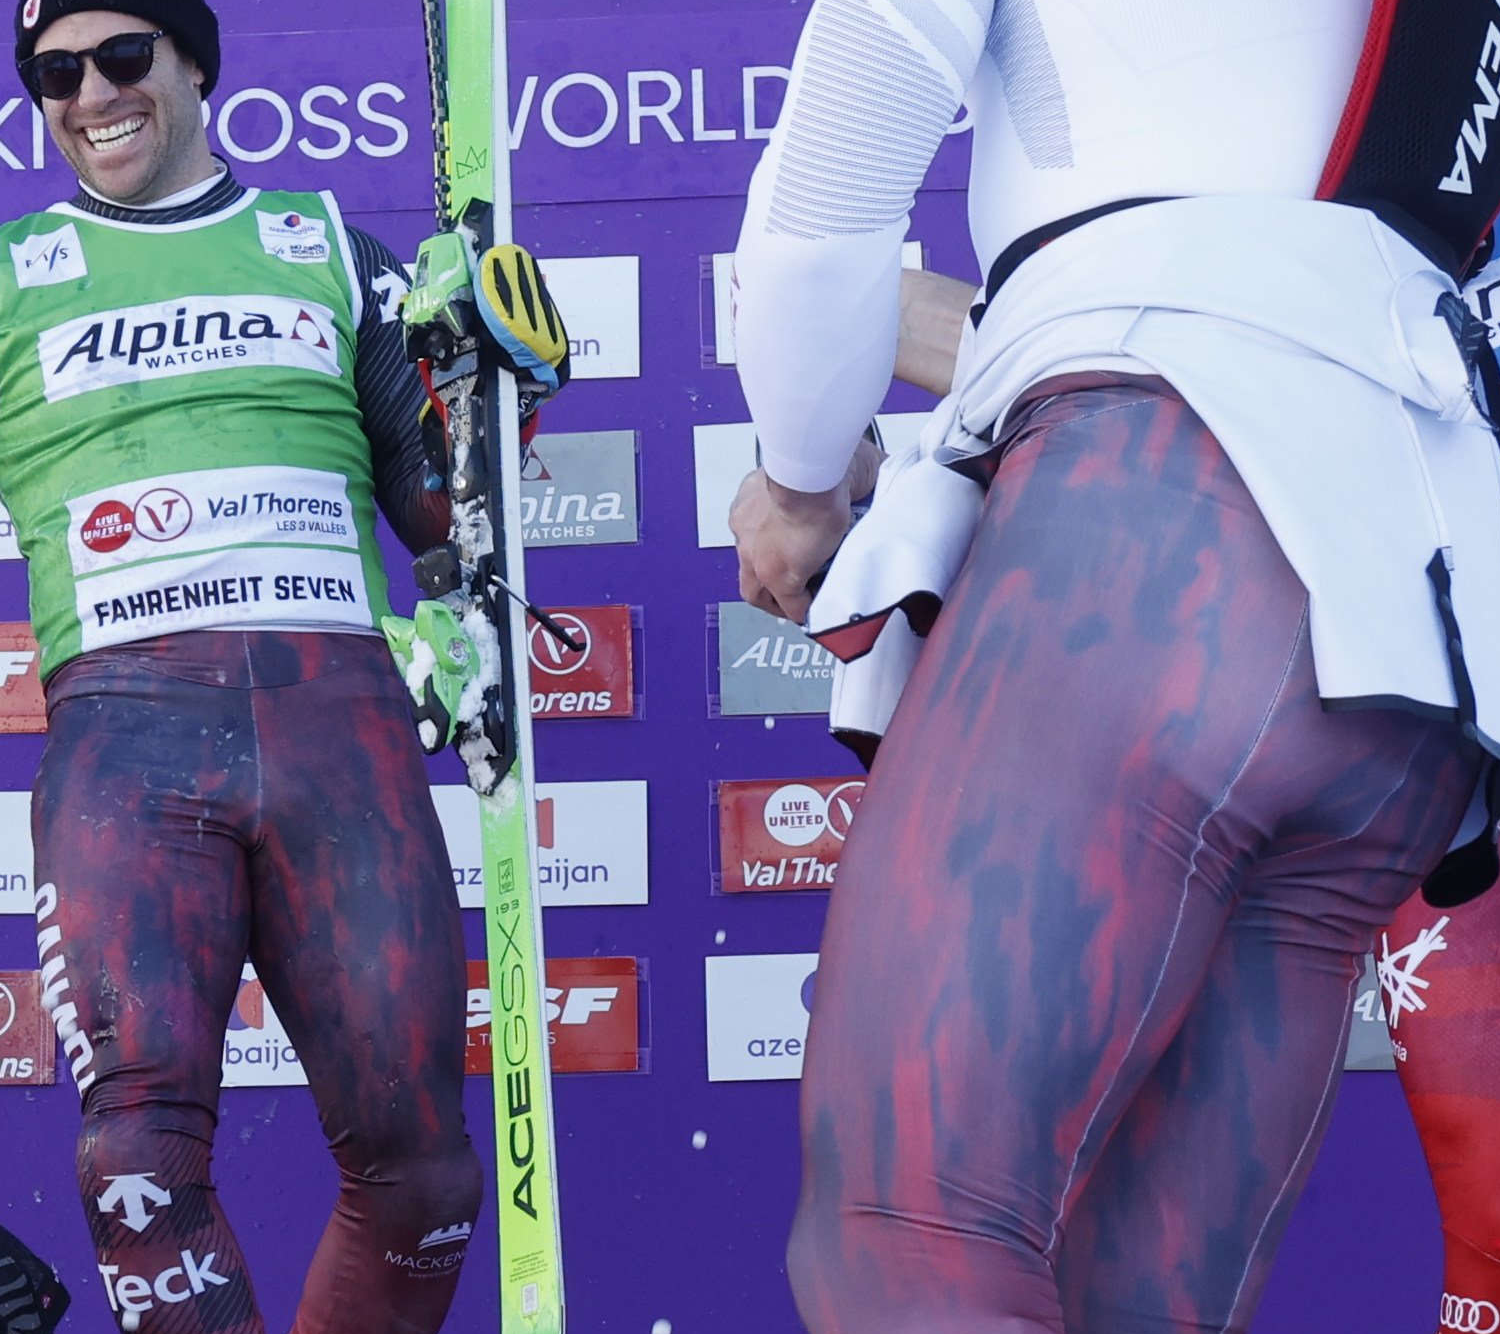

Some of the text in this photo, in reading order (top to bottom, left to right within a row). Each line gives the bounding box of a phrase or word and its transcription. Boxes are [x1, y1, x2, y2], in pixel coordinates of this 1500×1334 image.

[203, 81, 410, 164] OSS
[53, 307, 282, 376] Alpina
[144, 344, 248, 370] WATCHES
[207, 492, 343, 519] Val Thorens
[521, 485, 626, 528] pina
[83, 521, 134, 541] UNITED
[94, 512, 122, 528] LIVE
[276, 520, 296, 532] LES
[298, 520, 306, 531] 3
[94, 575, 356, 627] FAHRENHEIT SEVEN
[530, 690, 612, 714] orens
[781, 800, 810, 812] LIVE
[769, 814, 824, 827] UNITED
[742, 859, 786, 887] Val
[495, 898, 521, 916] 193
[384, 1248, 466, 1271] MACKEN
[98, 1245, 230, 1314] Teck
